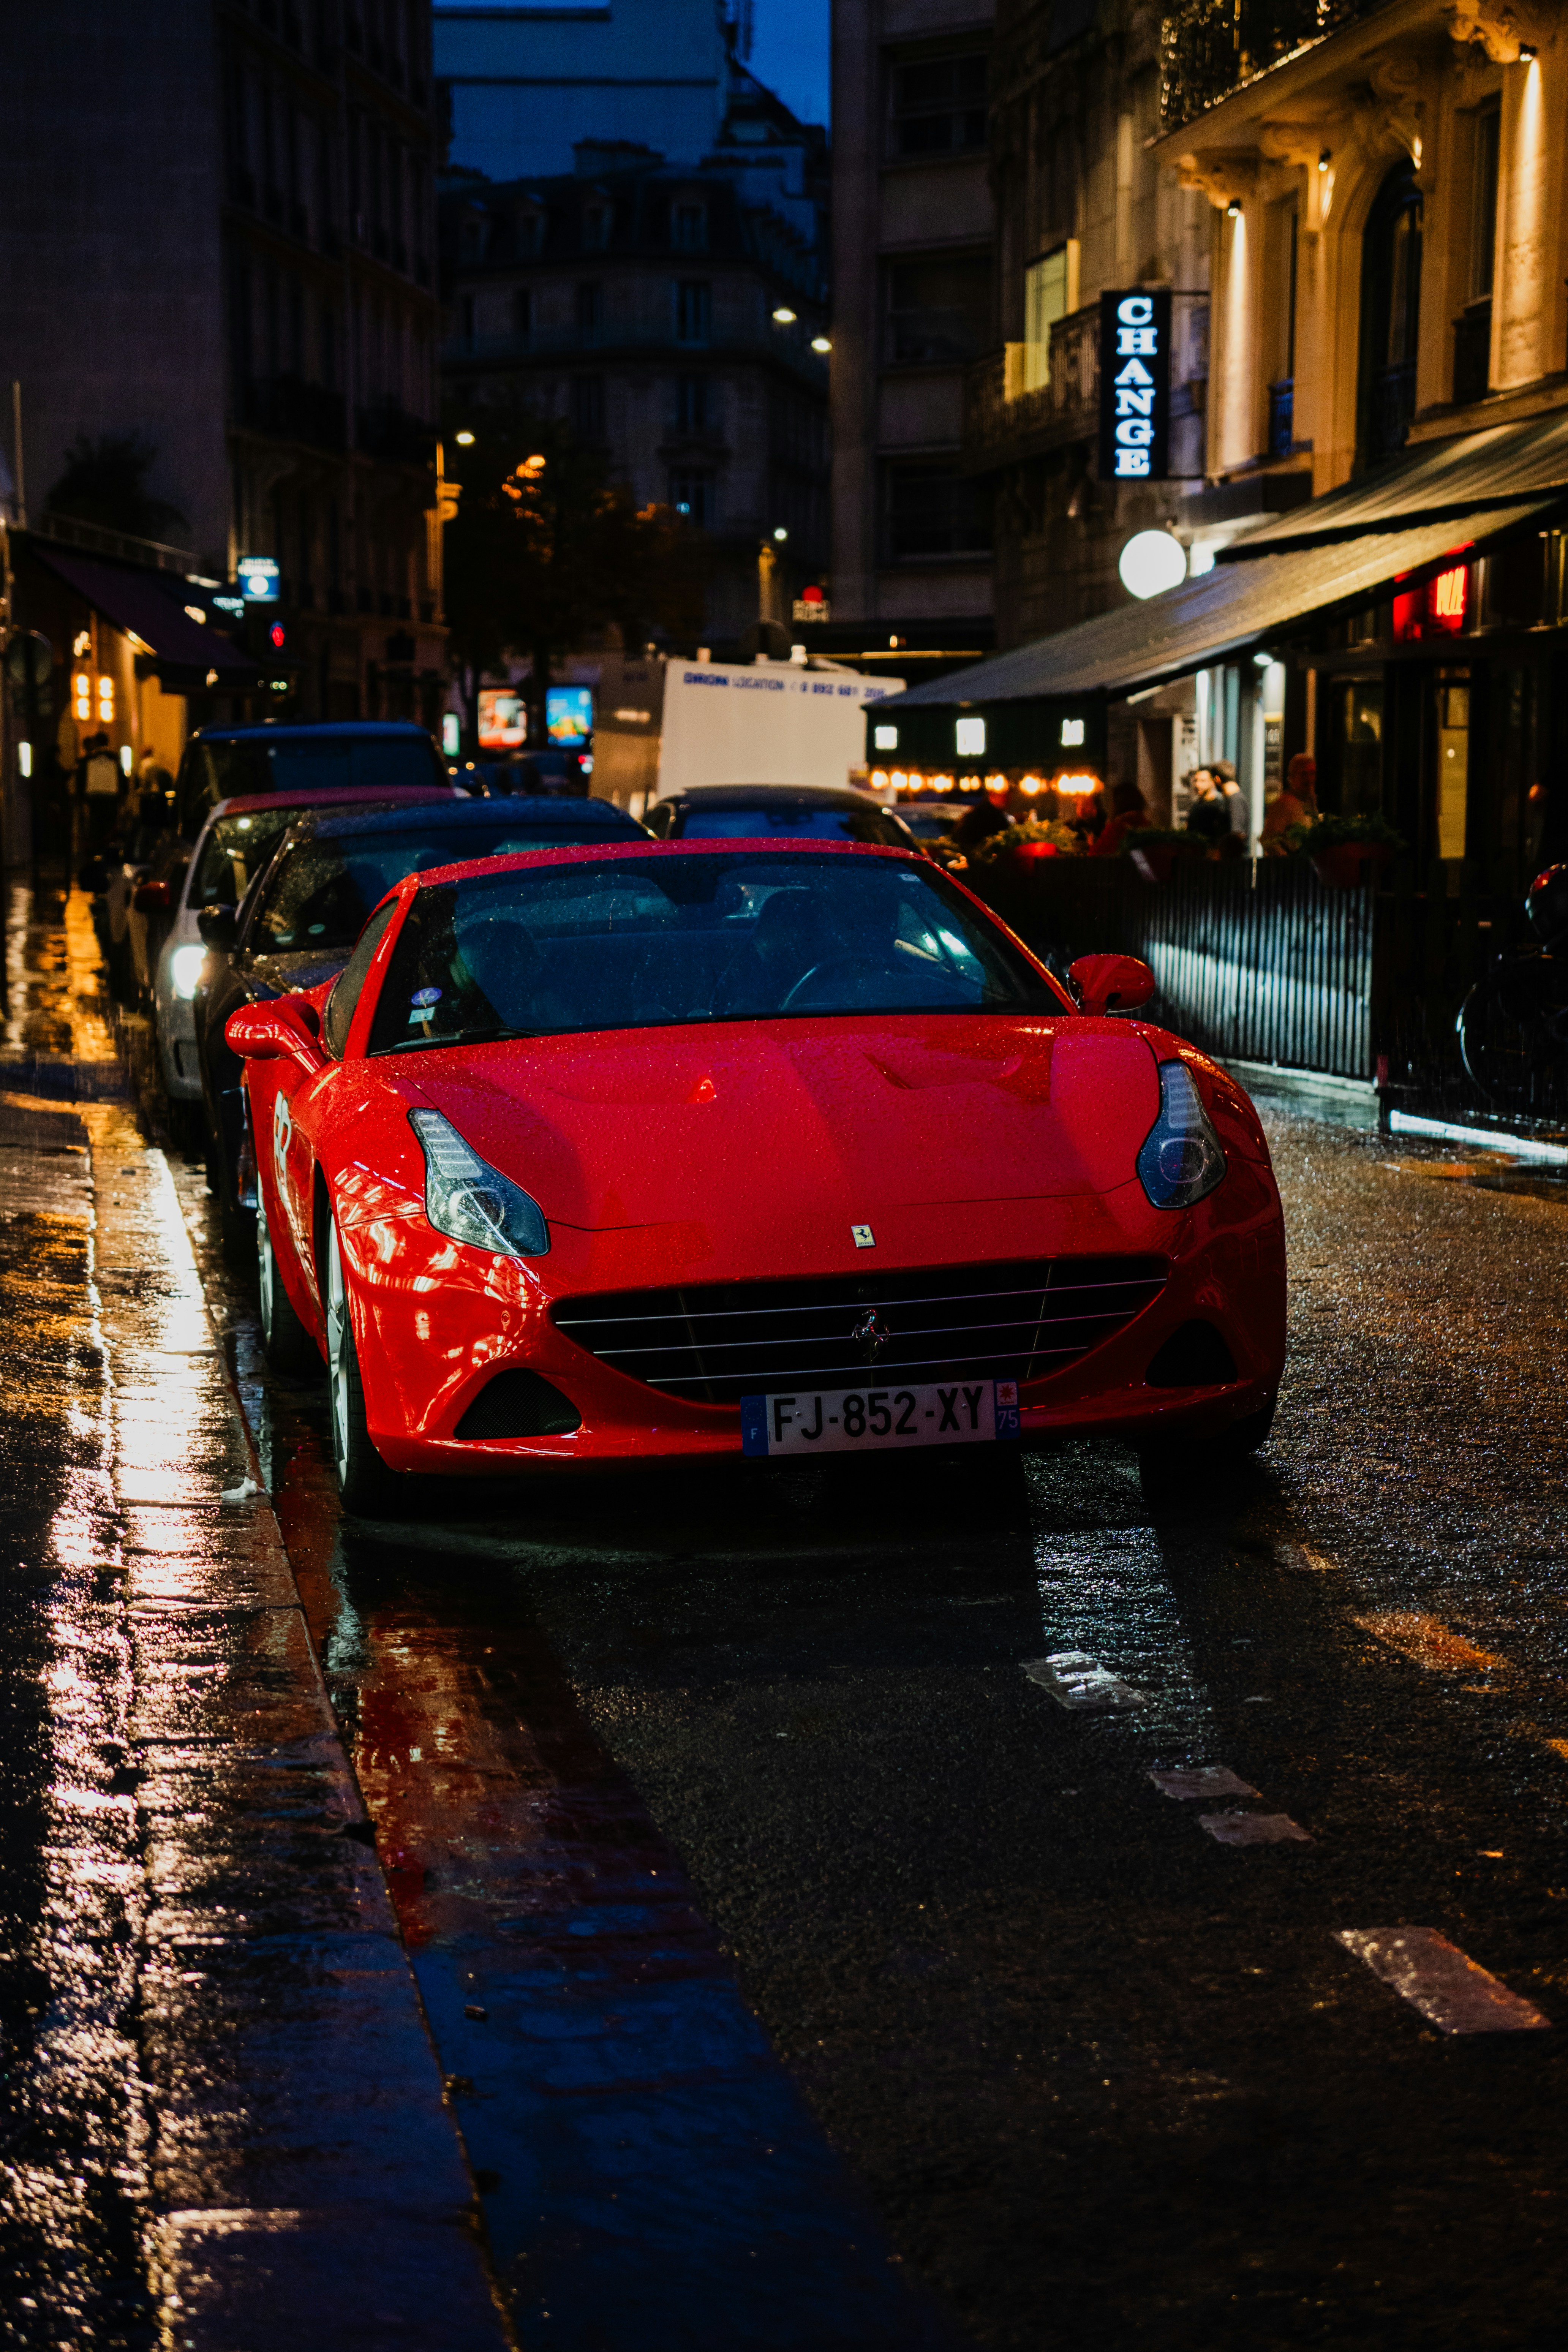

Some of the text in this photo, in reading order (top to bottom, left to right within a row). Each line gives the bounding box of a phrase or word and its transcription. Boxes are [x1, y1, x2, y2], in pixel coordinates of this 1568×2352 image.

[1114, 297, 1157, 476] CHANGE
[774, 1386, 983, 1442] FJ-852-XY
[998, 1409, 1018, 1430] 75
[751, 1428, 758, 1440] F
